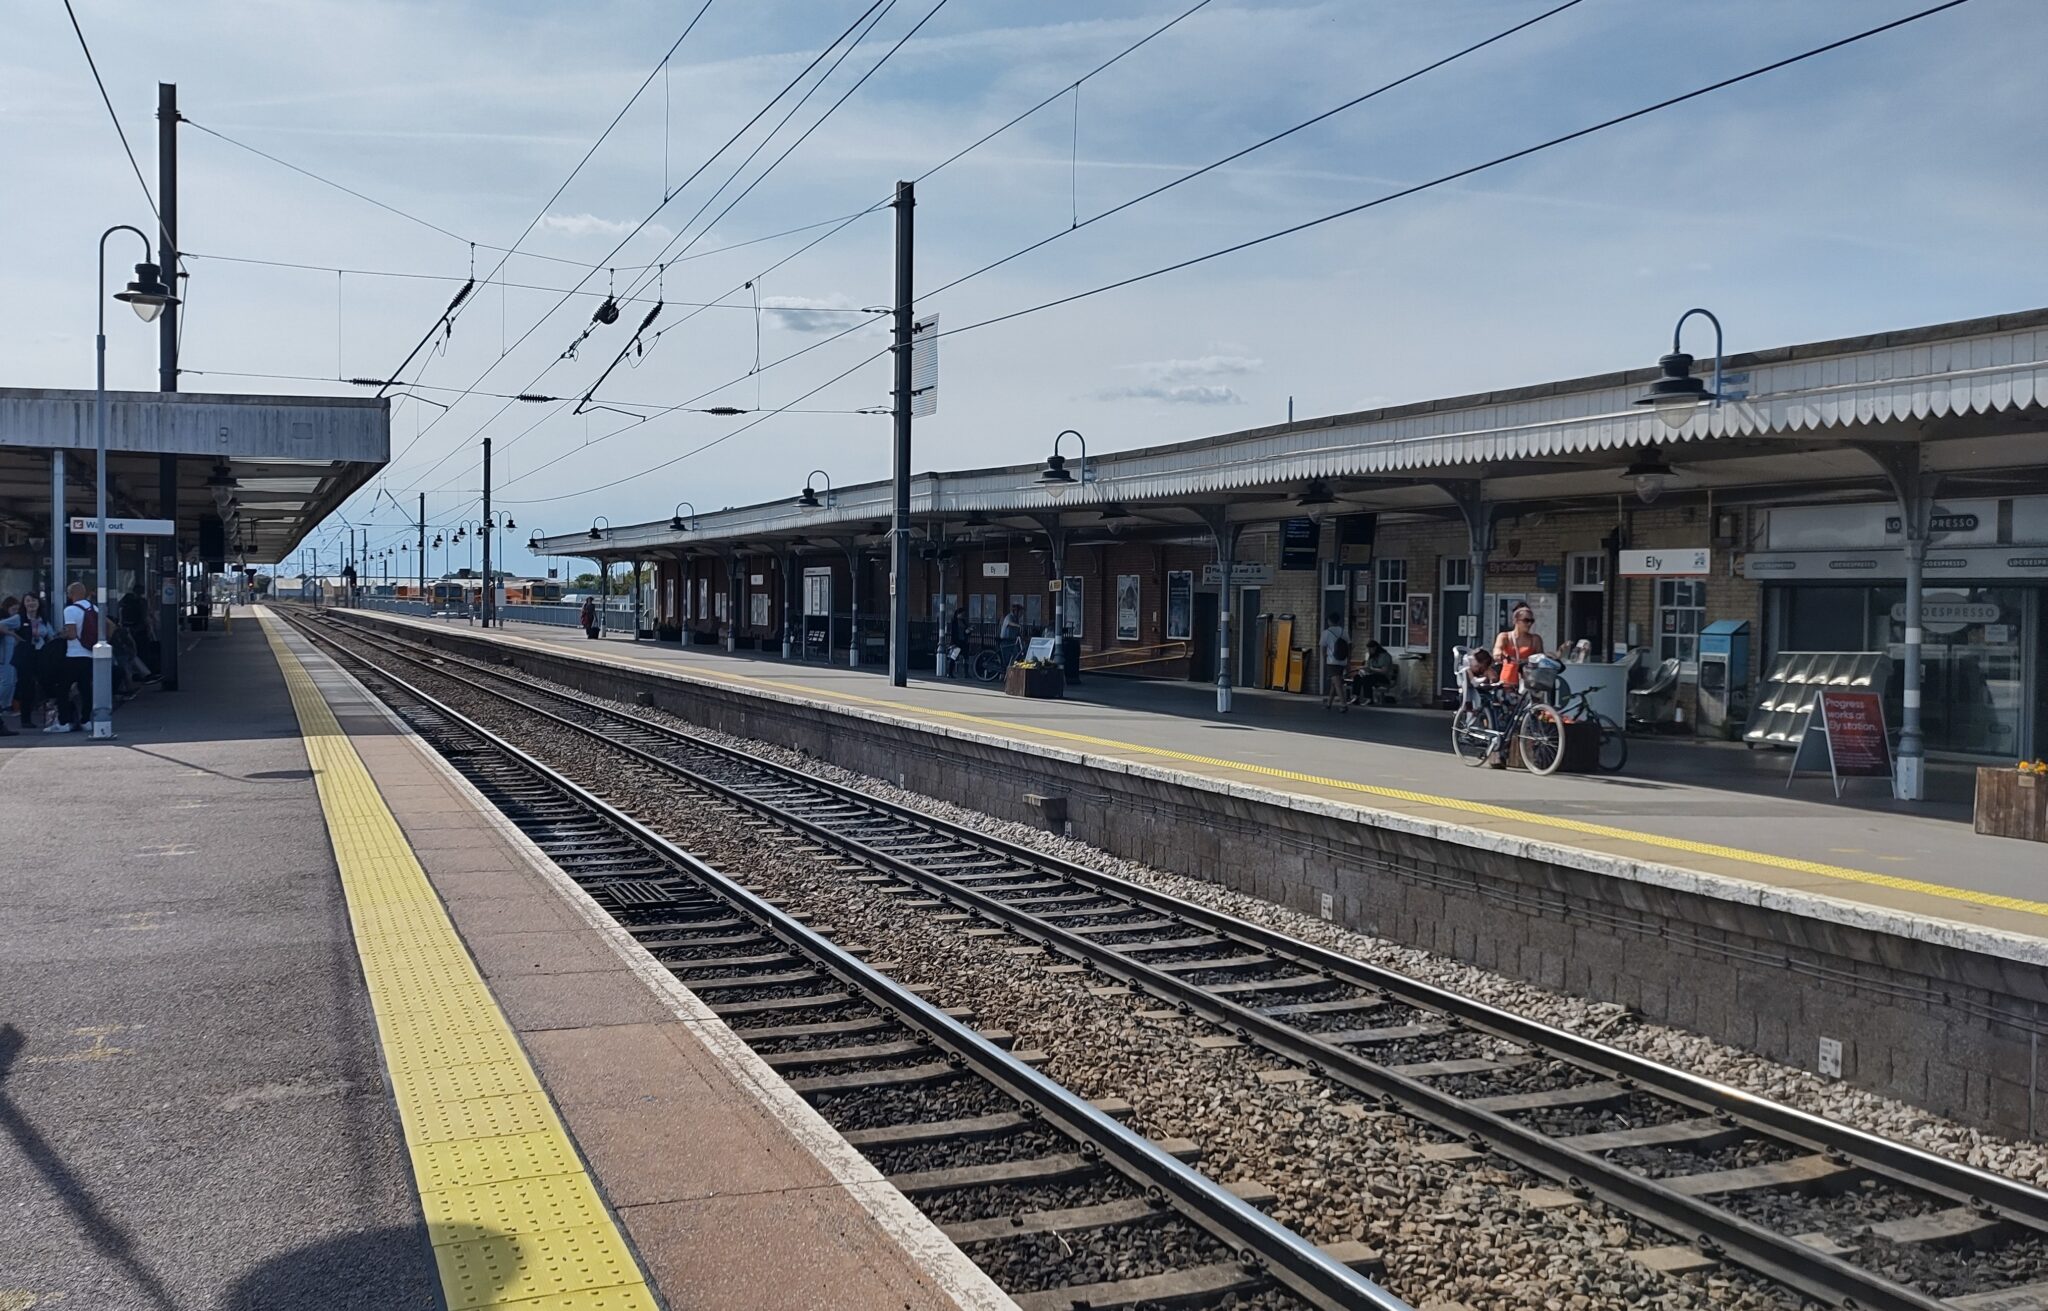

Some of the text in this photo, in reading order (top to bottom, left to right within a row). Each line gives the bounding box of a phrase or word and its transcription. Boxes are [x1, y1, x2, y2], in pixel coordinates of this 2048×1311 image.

[108, 522, 124, 530] out
[1886, 518, 1974, 530] LOPRESSO
[1645, 555, 1663, 571] Ely
[1895, 607, 1995, 618] LOESPRESSO
[1825, 698, 1864, 709] Progress
[1828, 711, 1865, 720] works at
[1829, 721, 1878, 732] Ely station.
